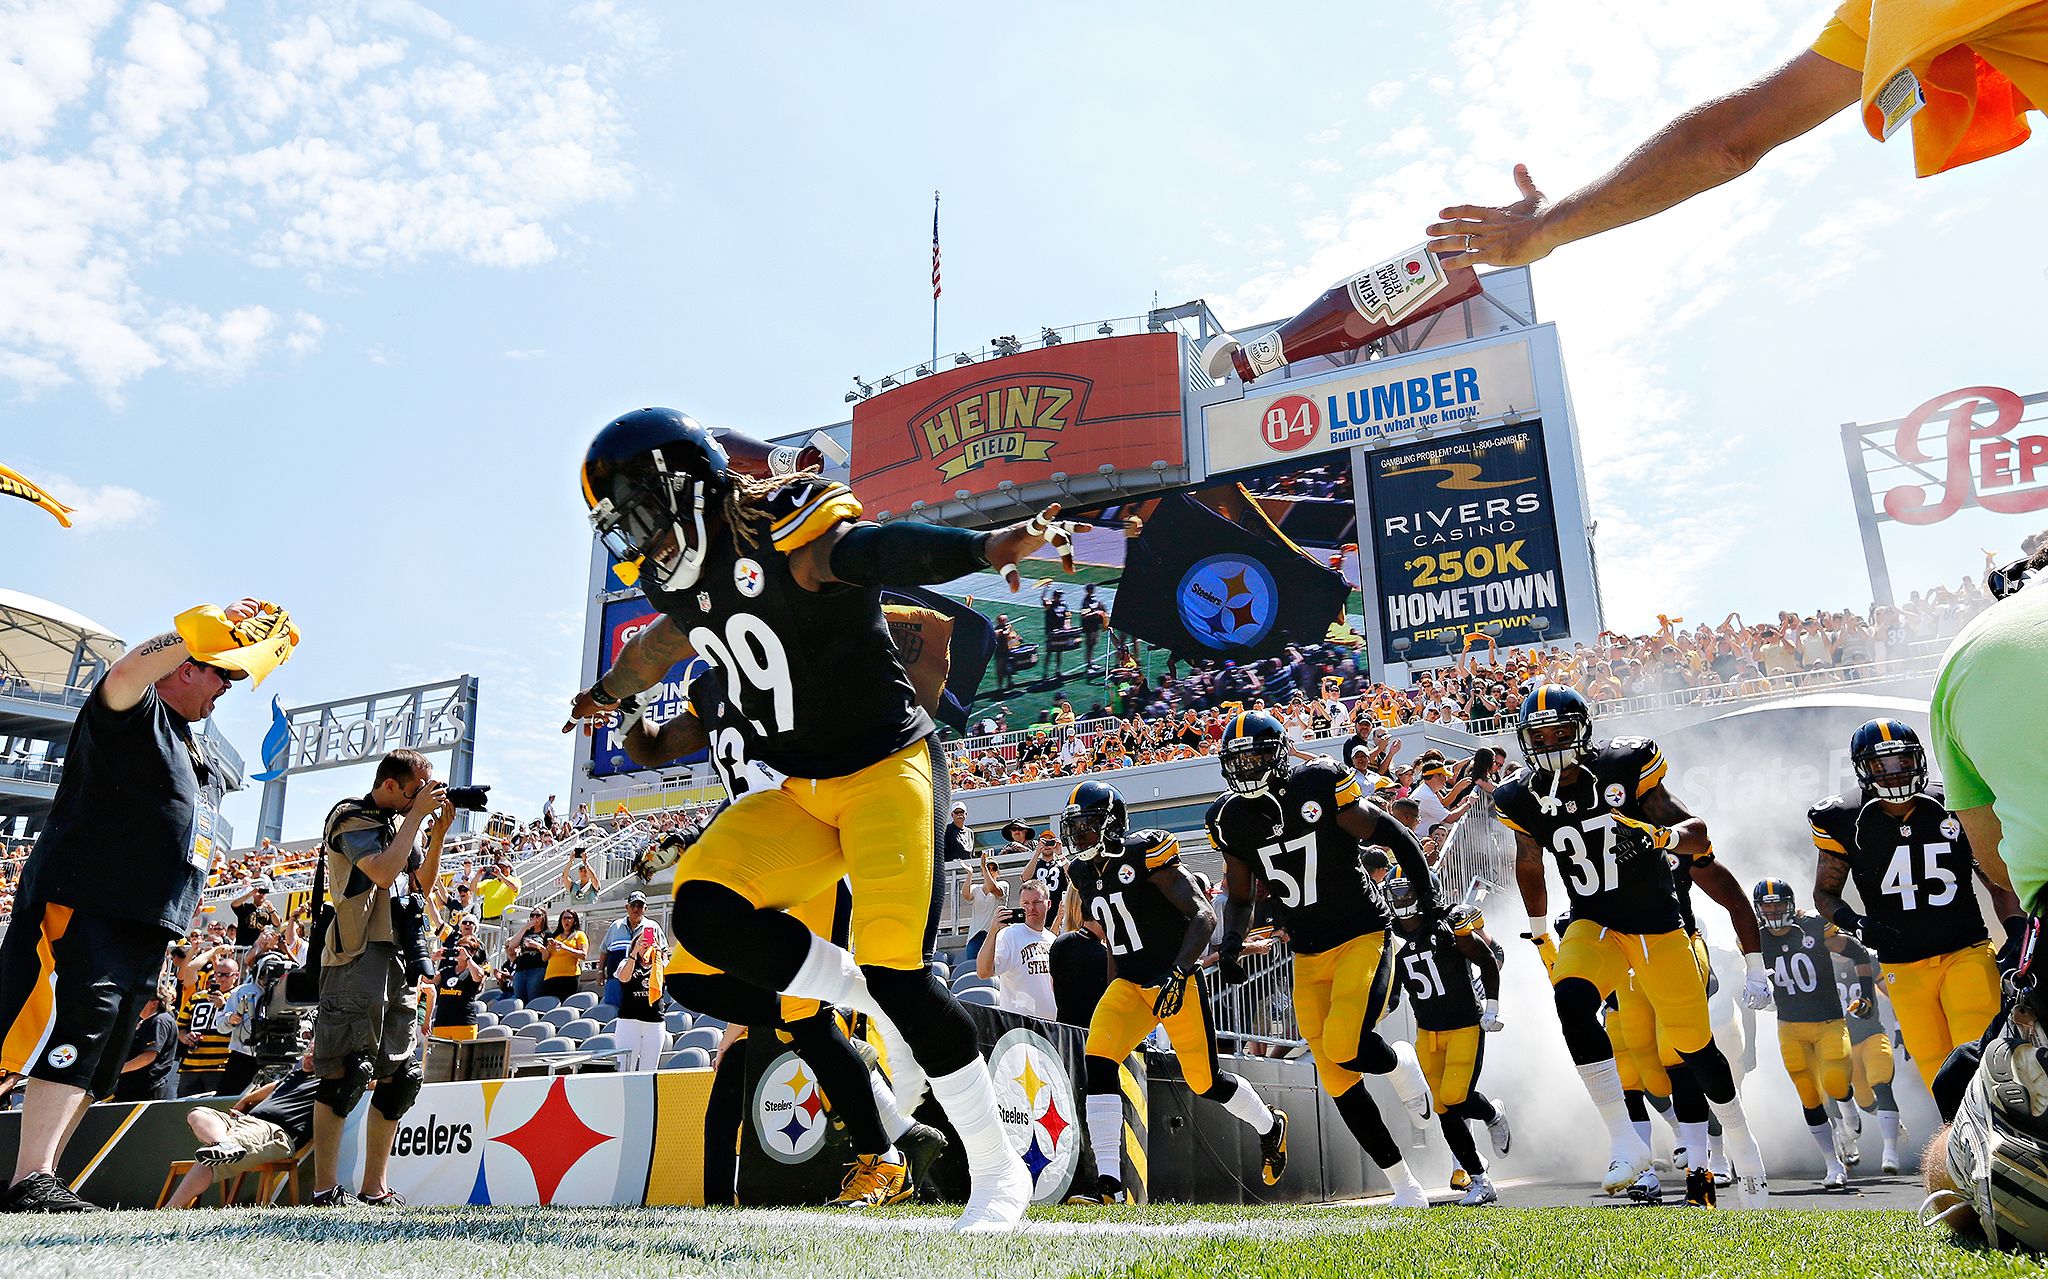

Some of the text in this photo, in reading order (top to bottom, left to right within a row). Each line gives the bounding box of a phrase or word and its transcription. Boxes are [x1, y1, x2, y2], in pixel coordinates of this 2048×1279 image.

[1376, 268, 1397, 302] TOMAT
[1386, 263, 1405, 295] KETCHU
[1258, 341, 1270, 353] 57
[1327, 367, 1481, 431] LUMBER
[921, 385, 1074, 460] HEINZ
[1267, 403, 1314, 444] 84
[1330, 405, 1480, 444] Build on what we know.
[972, 435, 1017, 461] FIELD
[1381, 451, 1416, 468] GAMBLING
[1416, 447, 1453, 463] PROBLEM?
[1453, 443, 1471, 455] CALL
[1385, 493, 1540, 537] RIVERS
[1413, 520, 1516, 547] CASINO
[1404, 539, 1529, 588] $250K
[1191, 582, 1223, 606] Steelers
[1388, 569, 1558, 632] HOMETOWN
[689, 612, 795, 737] 29
[294, 701, 468, 768] PEOPLES
[1164, 730, 1174, 741] 26
[1683, 756, 1821, 815] State
[1257, 830, 1318, 909] 57
[1552, 812, 1619, 897] 37
[1880, 841, 1959, 911] 45
[1036, 866, 1060, 892] 83
[1091, 891, 1144, 956] 21
[1028, 960, 1049, 975] STEE
[1403, 949, 1446, 1000] 51
[1774, 952, 1818, 996] 40
[764, 1100, 793, 1113] Steelers
[390, 1113, 473, 1157] teelers
